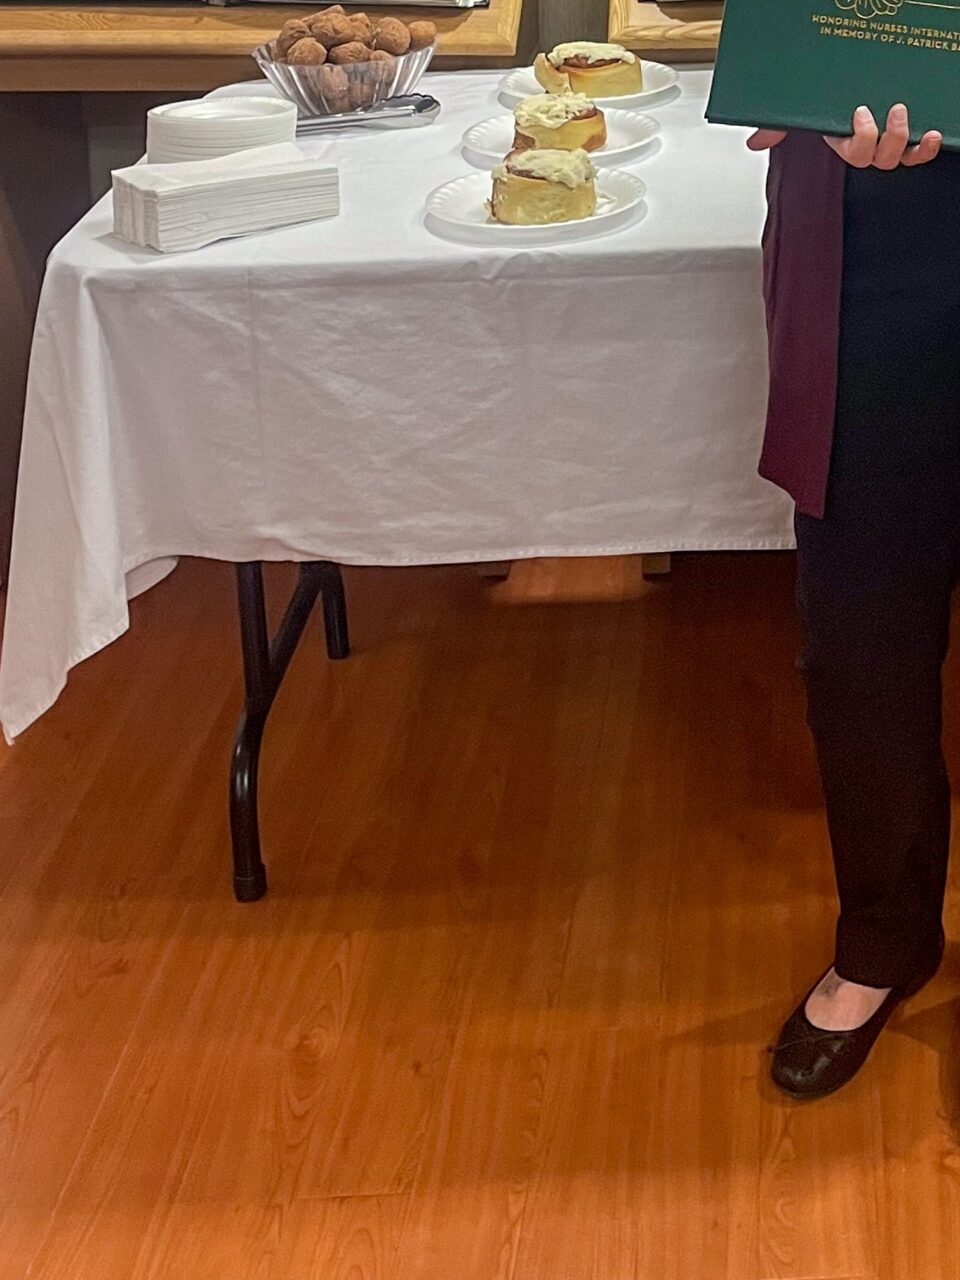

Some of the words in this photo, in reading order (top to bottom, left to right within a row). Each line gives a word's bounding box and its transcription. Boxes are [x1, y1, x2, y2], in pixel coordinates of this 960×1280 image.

[812, 14, 867, 29] HONORING
[870, 21, 908, 34] NURSES
[820, 27, 831, 36] IN
[833, 28, 878, 41] MEMORY
[880, 33, 894, 43] OF
[896, 36, 905, 45] J.
[907, 38, 950, 51] PATRICK
